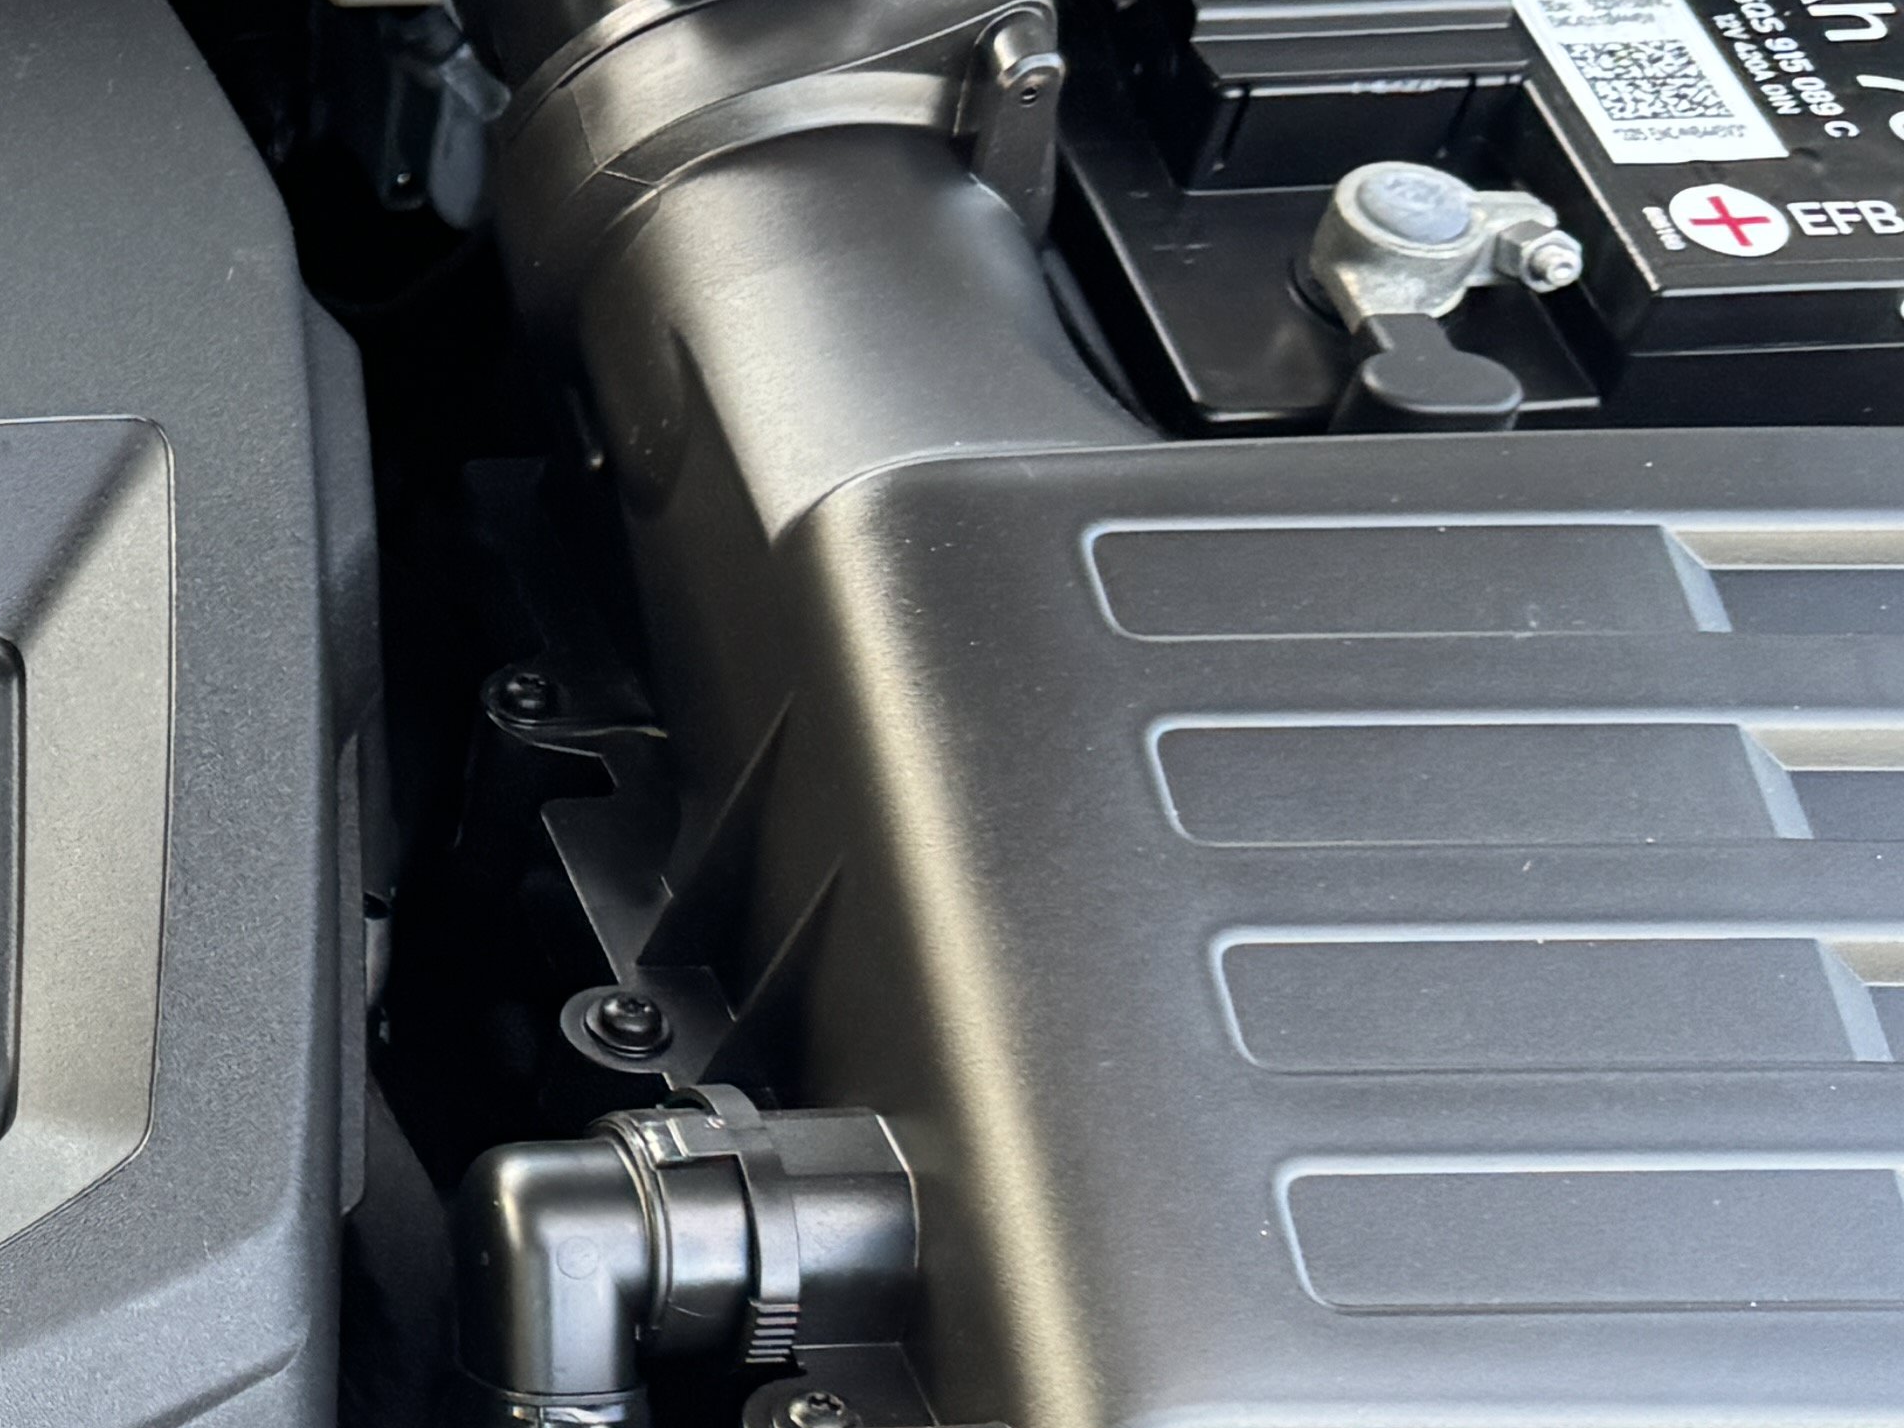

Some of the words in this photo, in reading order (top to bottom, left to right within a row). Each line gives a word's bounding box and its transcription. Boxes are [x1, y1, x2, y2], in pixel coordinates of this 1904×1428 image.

[1761, 83, 1802, 115] DIN
[1764, 37, 1815, 73] 915
[1791, 76, 1845, 117] 089
[1824, 120, 1860, 139] C
[1786, 200, 1904, 236] EFB
